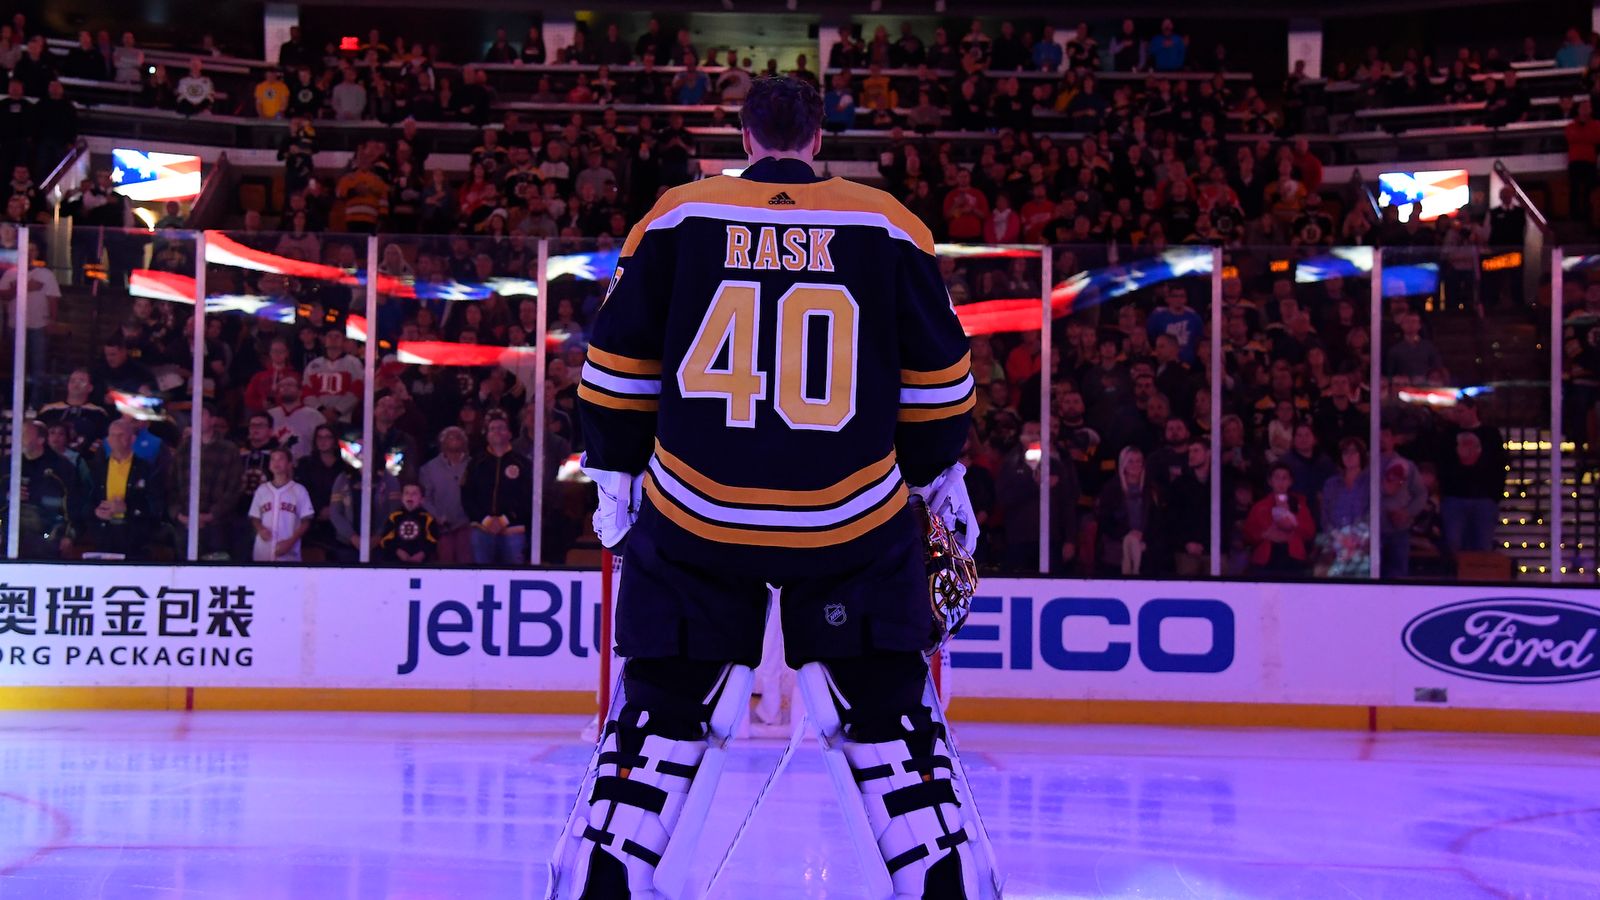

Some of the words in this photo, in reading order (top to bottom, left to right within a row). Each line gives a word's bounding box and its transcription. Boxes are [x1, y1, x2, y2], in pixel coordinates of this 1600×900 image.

[724, 225, 836, 272] RASK
[676, 280, 860, 433] 40
[0, 582, 255, 637] 奥瑞金包装
[397, 578, 603, 675] jetBl
[949, 594, 1236, 674] EICO
[0, 646, 51, 666] RG
[65, 646, 254, 668] PACKAGING
[1450, 610, 1597, 669] Ford
